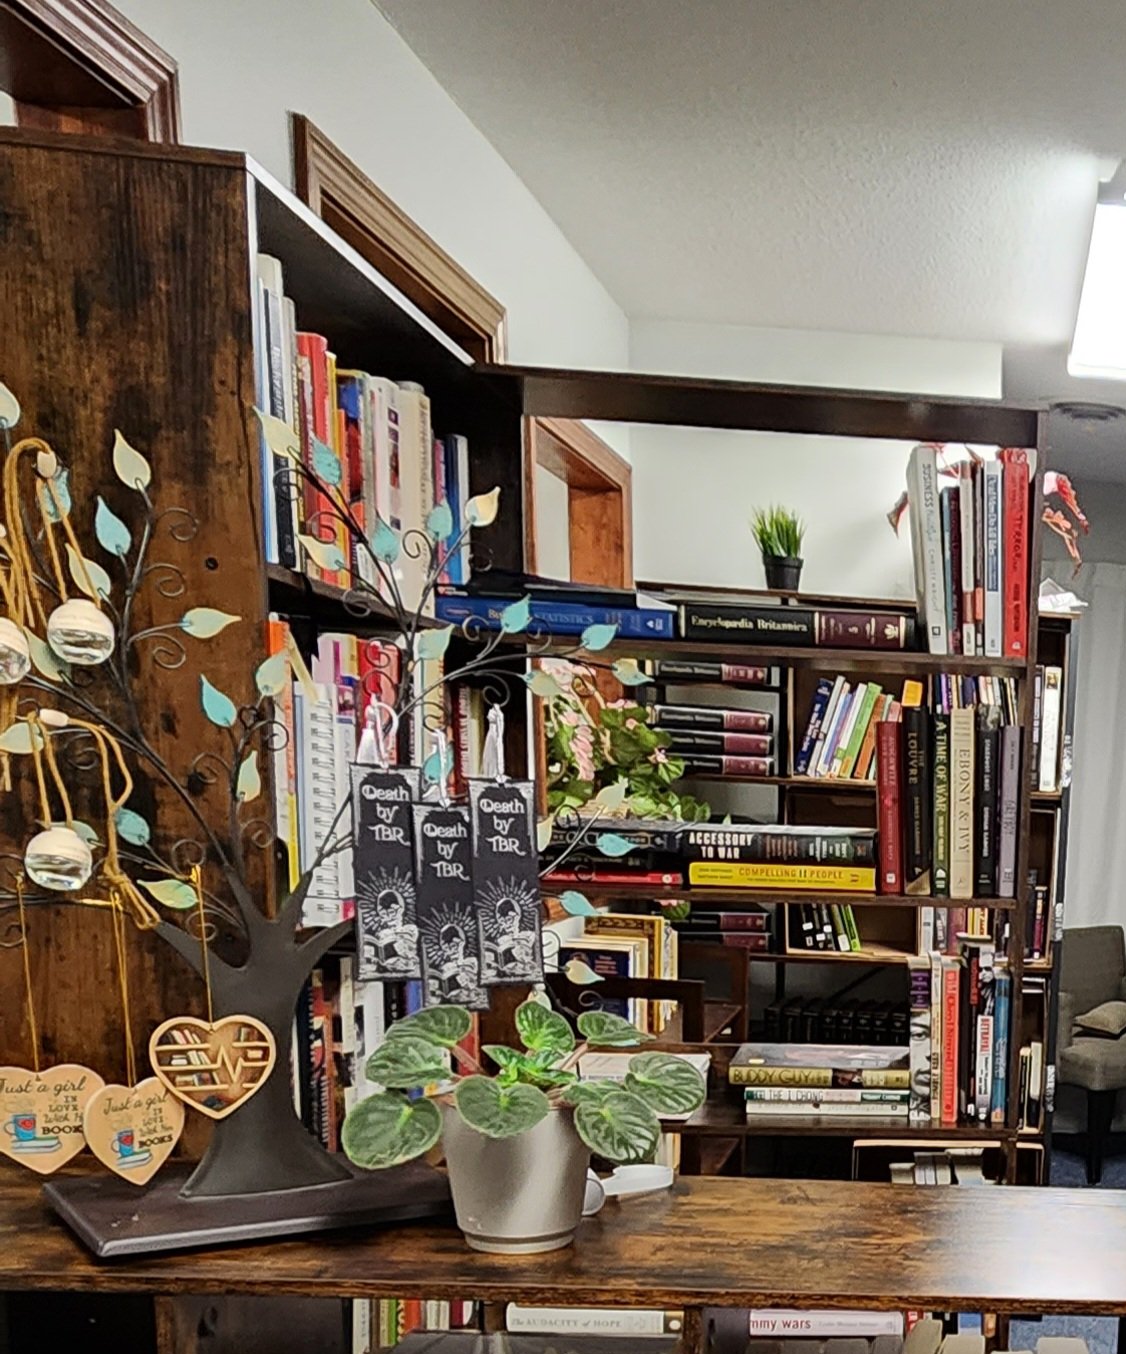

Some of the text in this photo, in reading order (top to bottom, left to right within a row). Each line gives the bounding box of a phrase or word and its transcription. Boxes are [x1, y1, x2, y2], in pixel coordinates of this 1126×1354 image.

[922, 463, 934, 508] BUSINESS
[907, 731, 919, 785] LOUVRE
[936, 722, 947, 812] A TIME OF WAR
[362, 783, 410, 801] Death
[957, 748, 971, 854] EBONY & IVY
[376, 803, 399, 823] by
[479, 798, 525, 814] Death
[368, 824, 411, 846] TBR
[423, 822, 468, 838] Death
[493, 816, 515, 835] by
[485, 836, 527, 856] TBR
[689, 831, 753, 848] ACCESSORY
[436, 841, 459, 860] by
[701, 847, 740, 862] TO WAR
[430, 861, 471, 881] TBR
[738, 866, 844, 882] COMPELLING PEOPLE
[37, 1083, 50, 1093] a
[53, 1074, 86, 1096] girl
[732, 1068, 810, 1085] BUDDY GUY
[103, 1091, 169, 1116] Just a girl
[41, 1125, 84, 1136] BOOK
[138, 1135, 173, 1150] BOOKS
[526, 1318, 579, 1329] AUDACITY
[593, 1319, 622, 1329] HOPE
[782, 1320, 811, 1331] wars
